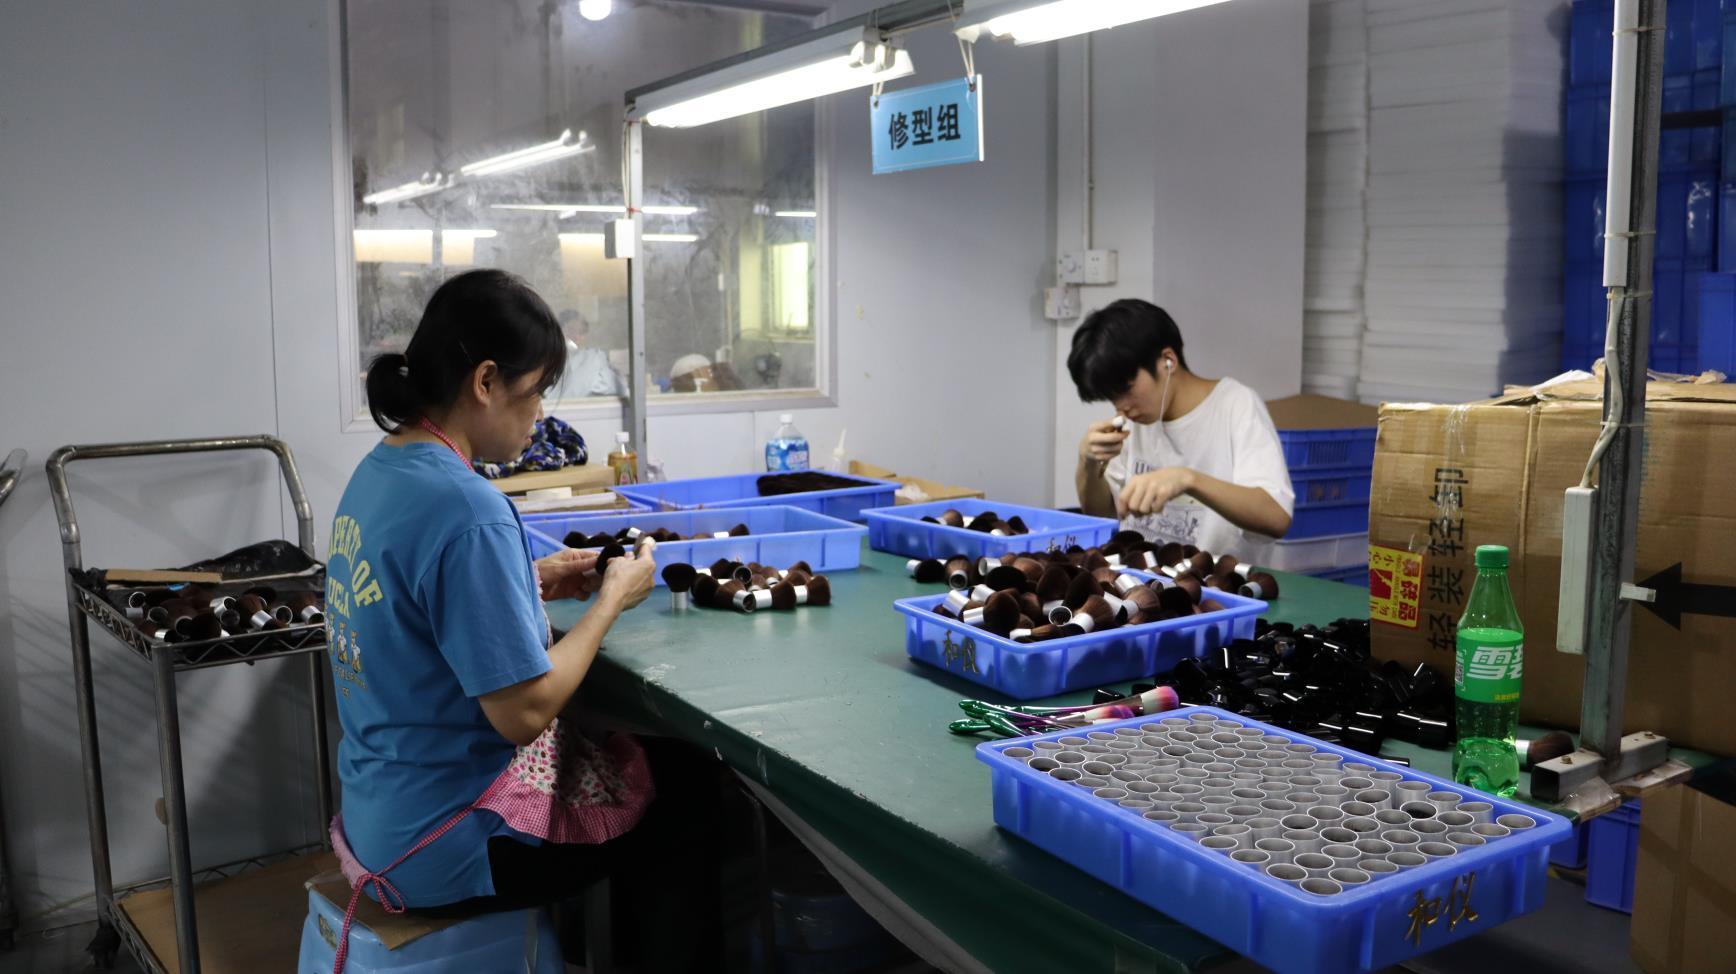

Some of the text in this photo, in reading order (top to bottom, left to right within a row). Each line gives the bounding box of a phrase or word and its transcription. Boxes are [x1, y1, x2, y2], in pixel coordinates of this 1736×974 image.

[888, 103, 961, 150] 修型组
[352, 560, 384, 608] OF
